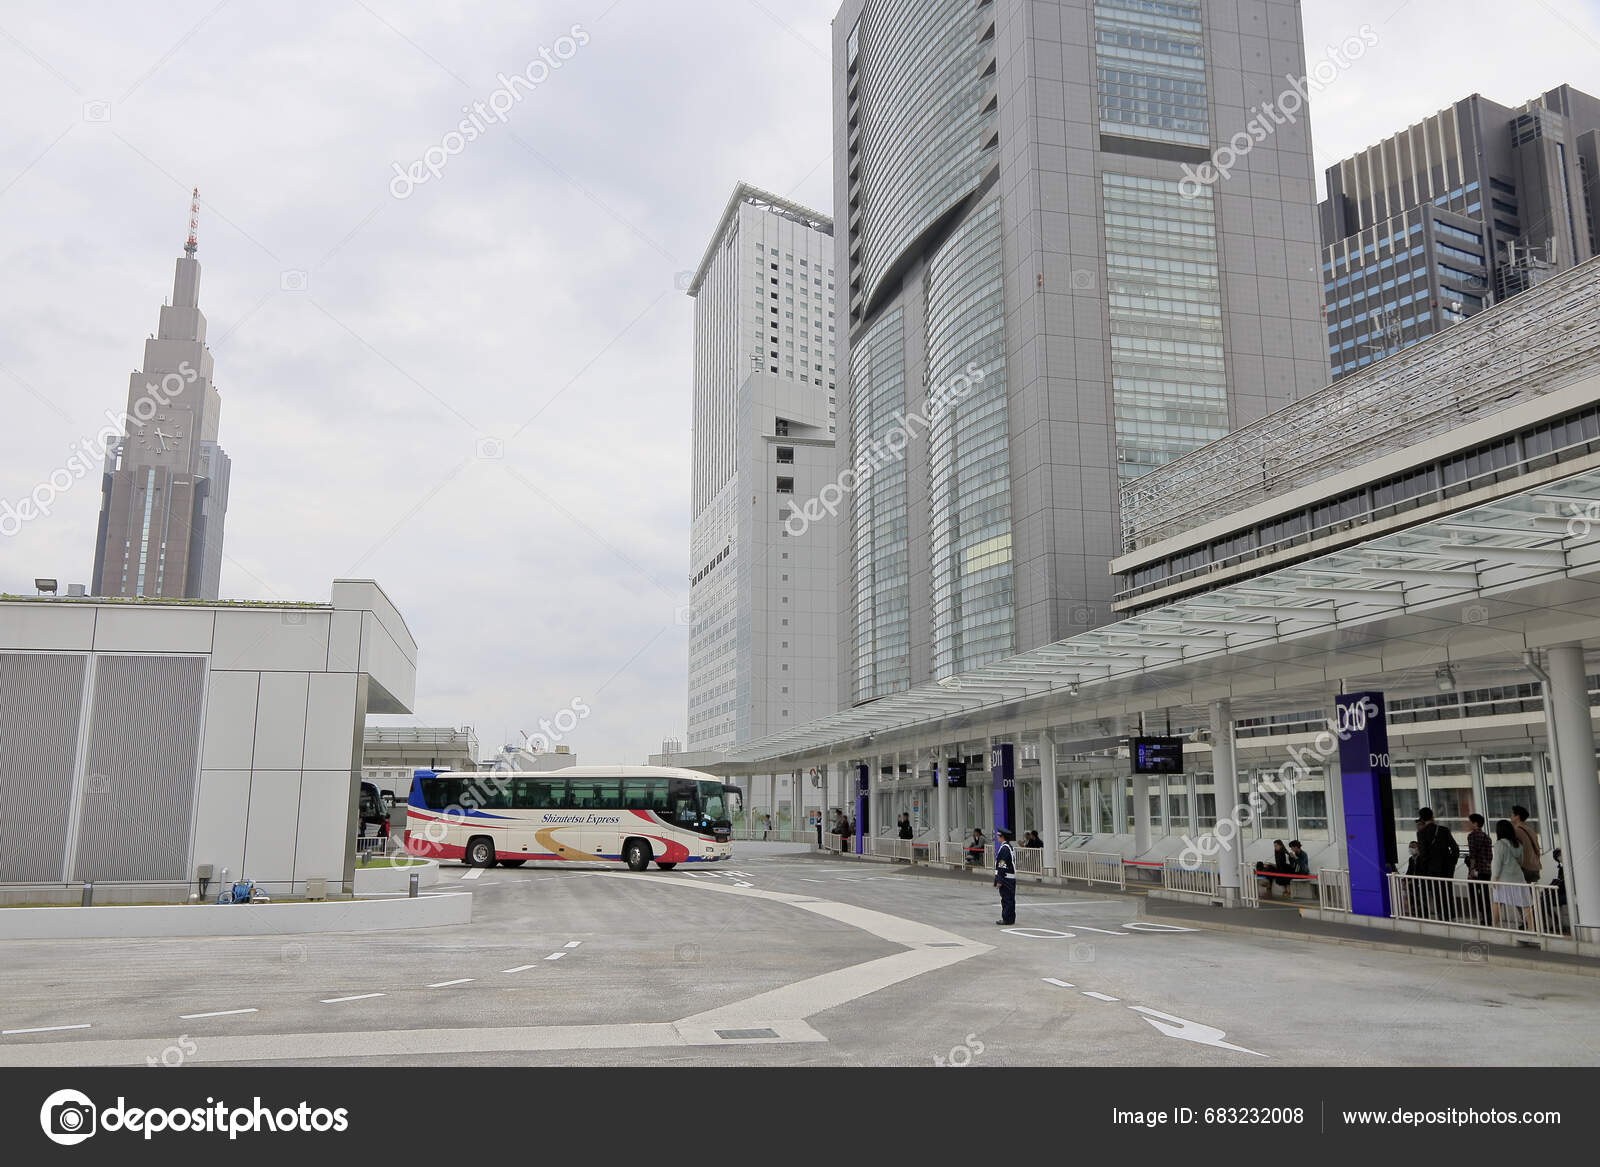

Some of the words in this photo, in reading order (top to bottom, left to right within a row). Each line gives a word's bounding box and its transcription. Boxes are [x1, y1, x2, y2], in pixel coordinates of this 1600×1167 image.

[1337, 702, 1366, 732] D10
[992, 750, 1003, 767] D11
[1369, 753, 1390, 767] D10
[1003, 778, 1015, 788] D11
[541, 814, 585, 824] Shizutetsu
[586, 814, 620, 825] Express
